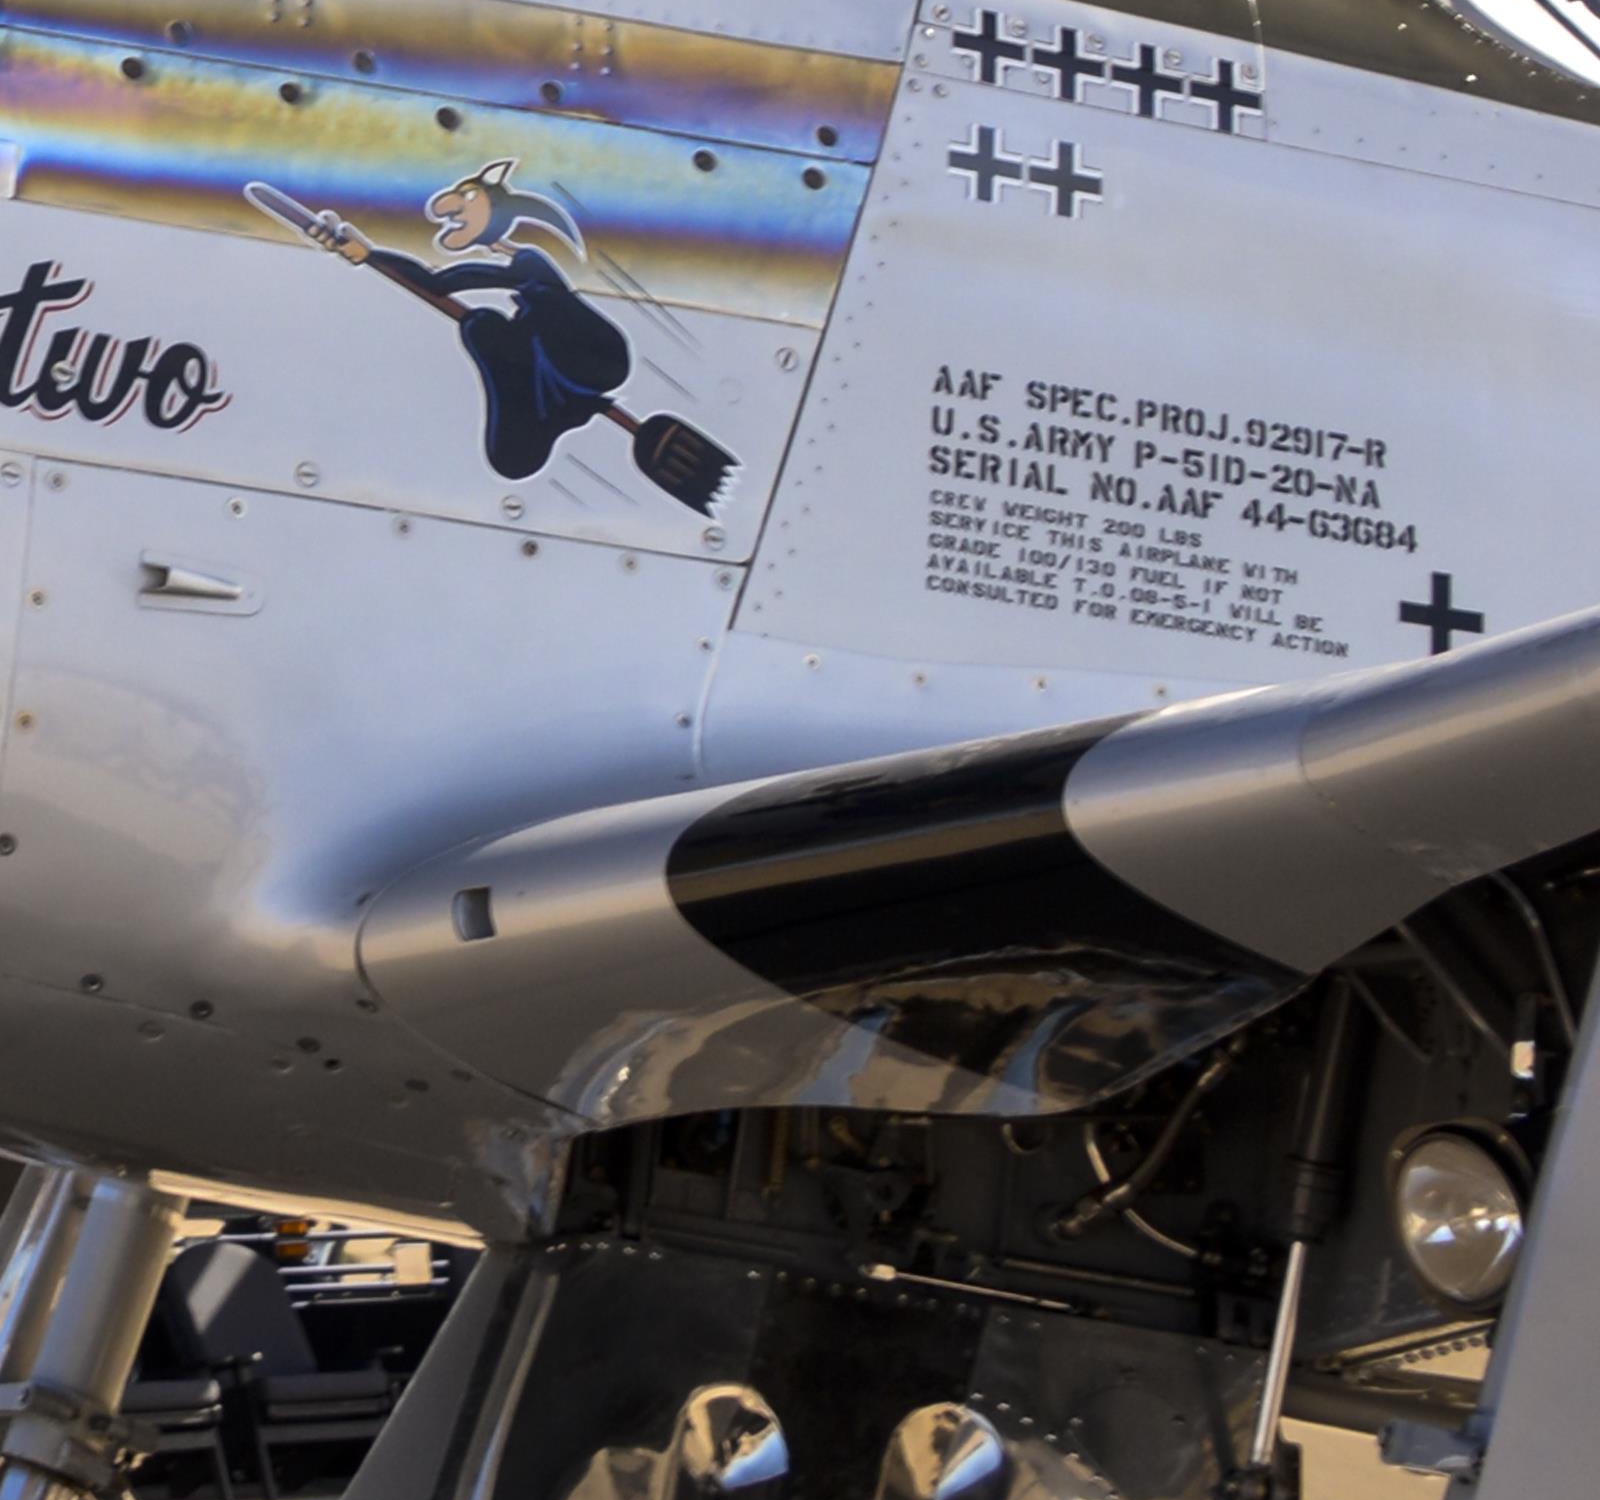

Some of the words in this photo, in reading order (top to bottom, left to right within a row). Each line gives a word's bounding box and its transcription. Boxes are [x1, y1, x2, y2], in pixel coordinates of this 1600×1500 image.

[932, 364, 1003, 401] AAF
[928, 444, 1069, 496] SERIAL
[928, 510, 1031, 541] SERVICE
[1046, 529, 1103, 553] THIS
[1118, 541, 1231, 574] AIRPLANE
[1242, 561, 1299, 585] WITH
[929, 489, 987, 512] CREW
[1002, 500, 1089, 529] WEIGHT
[1103, 517, 1146, 539] 200
[1159, 526, 1203, 548] LBS
[926, 553, 1057, 590] AVAILABLE
[1228, 602, 1282, 627] WILL
[1294, 613, 1324, 634] BE
[927, 532, 1001, 559] GRADE
[1018, 547, 1117, 578] 100/130
[1129, 566, 1186, 590] FUEL
[1203, 578, 1228, 595] IF
[1240, 583, 1285, 605] NOT
[925, 574, 1059, 611] CONSULTED
[1073, 599, 1118, 621] FOR
[1128, 608, 1257, 643] EMERGENCY
[1271, 631, 1350, 658] ACTION
